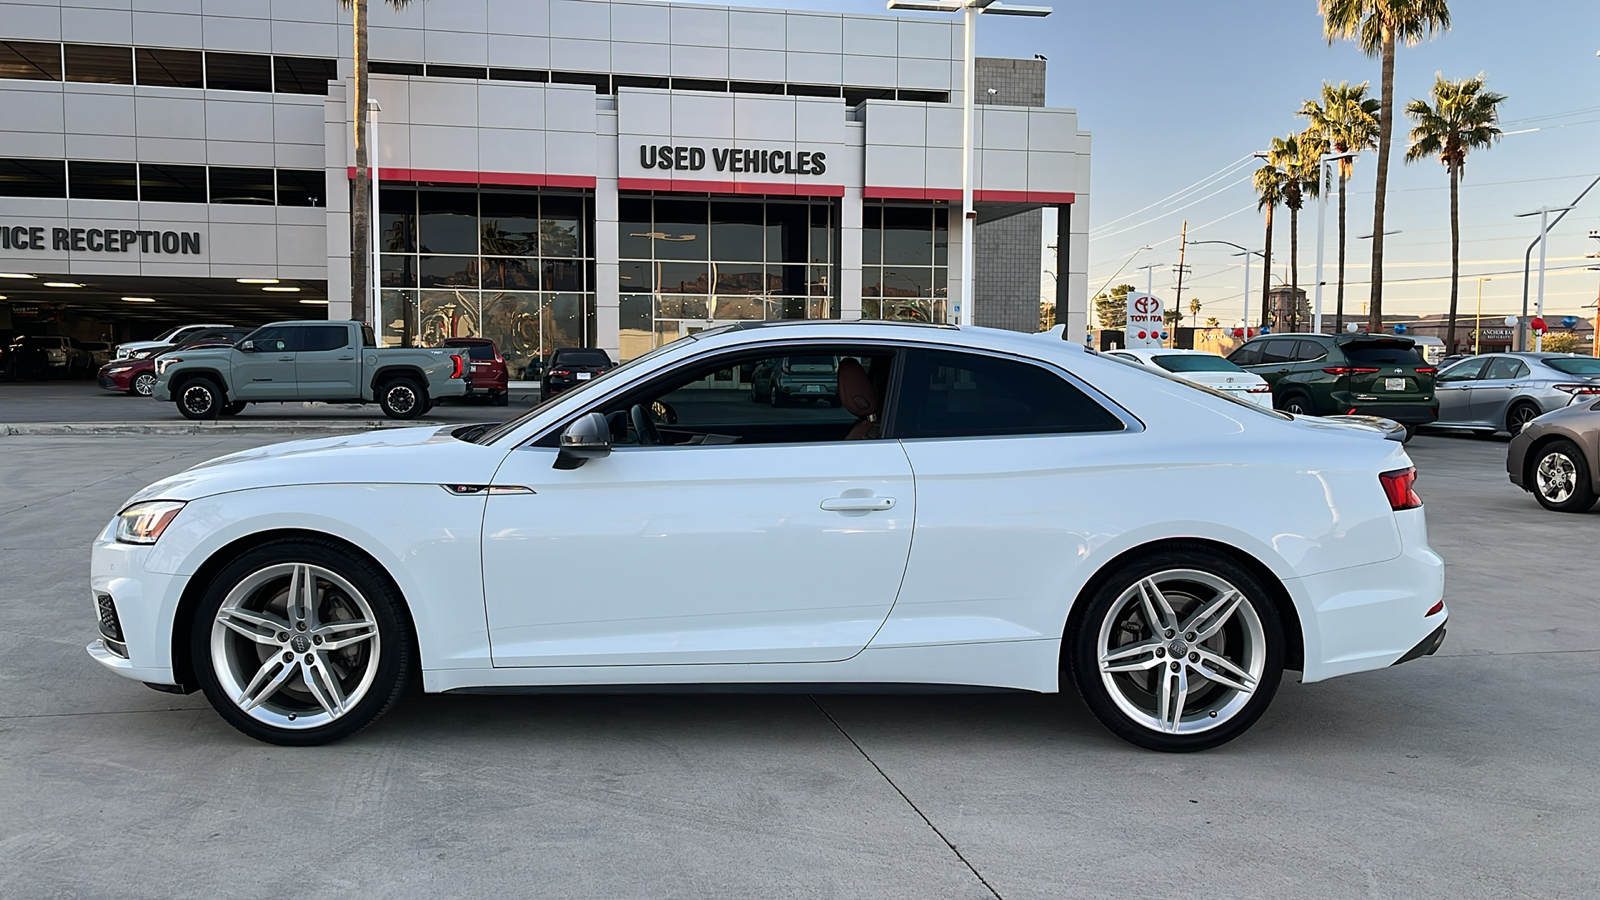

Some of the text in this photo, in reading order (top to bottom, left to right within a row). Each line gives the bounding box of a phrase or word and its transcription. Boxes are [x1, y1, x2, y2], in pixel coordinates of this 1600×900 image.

[640, 145, 826, 175] USED VEHICLES
[0, 226, 200, 254] ICE RECEPTION
[1130, 314, 1162, 322] TOYTA
